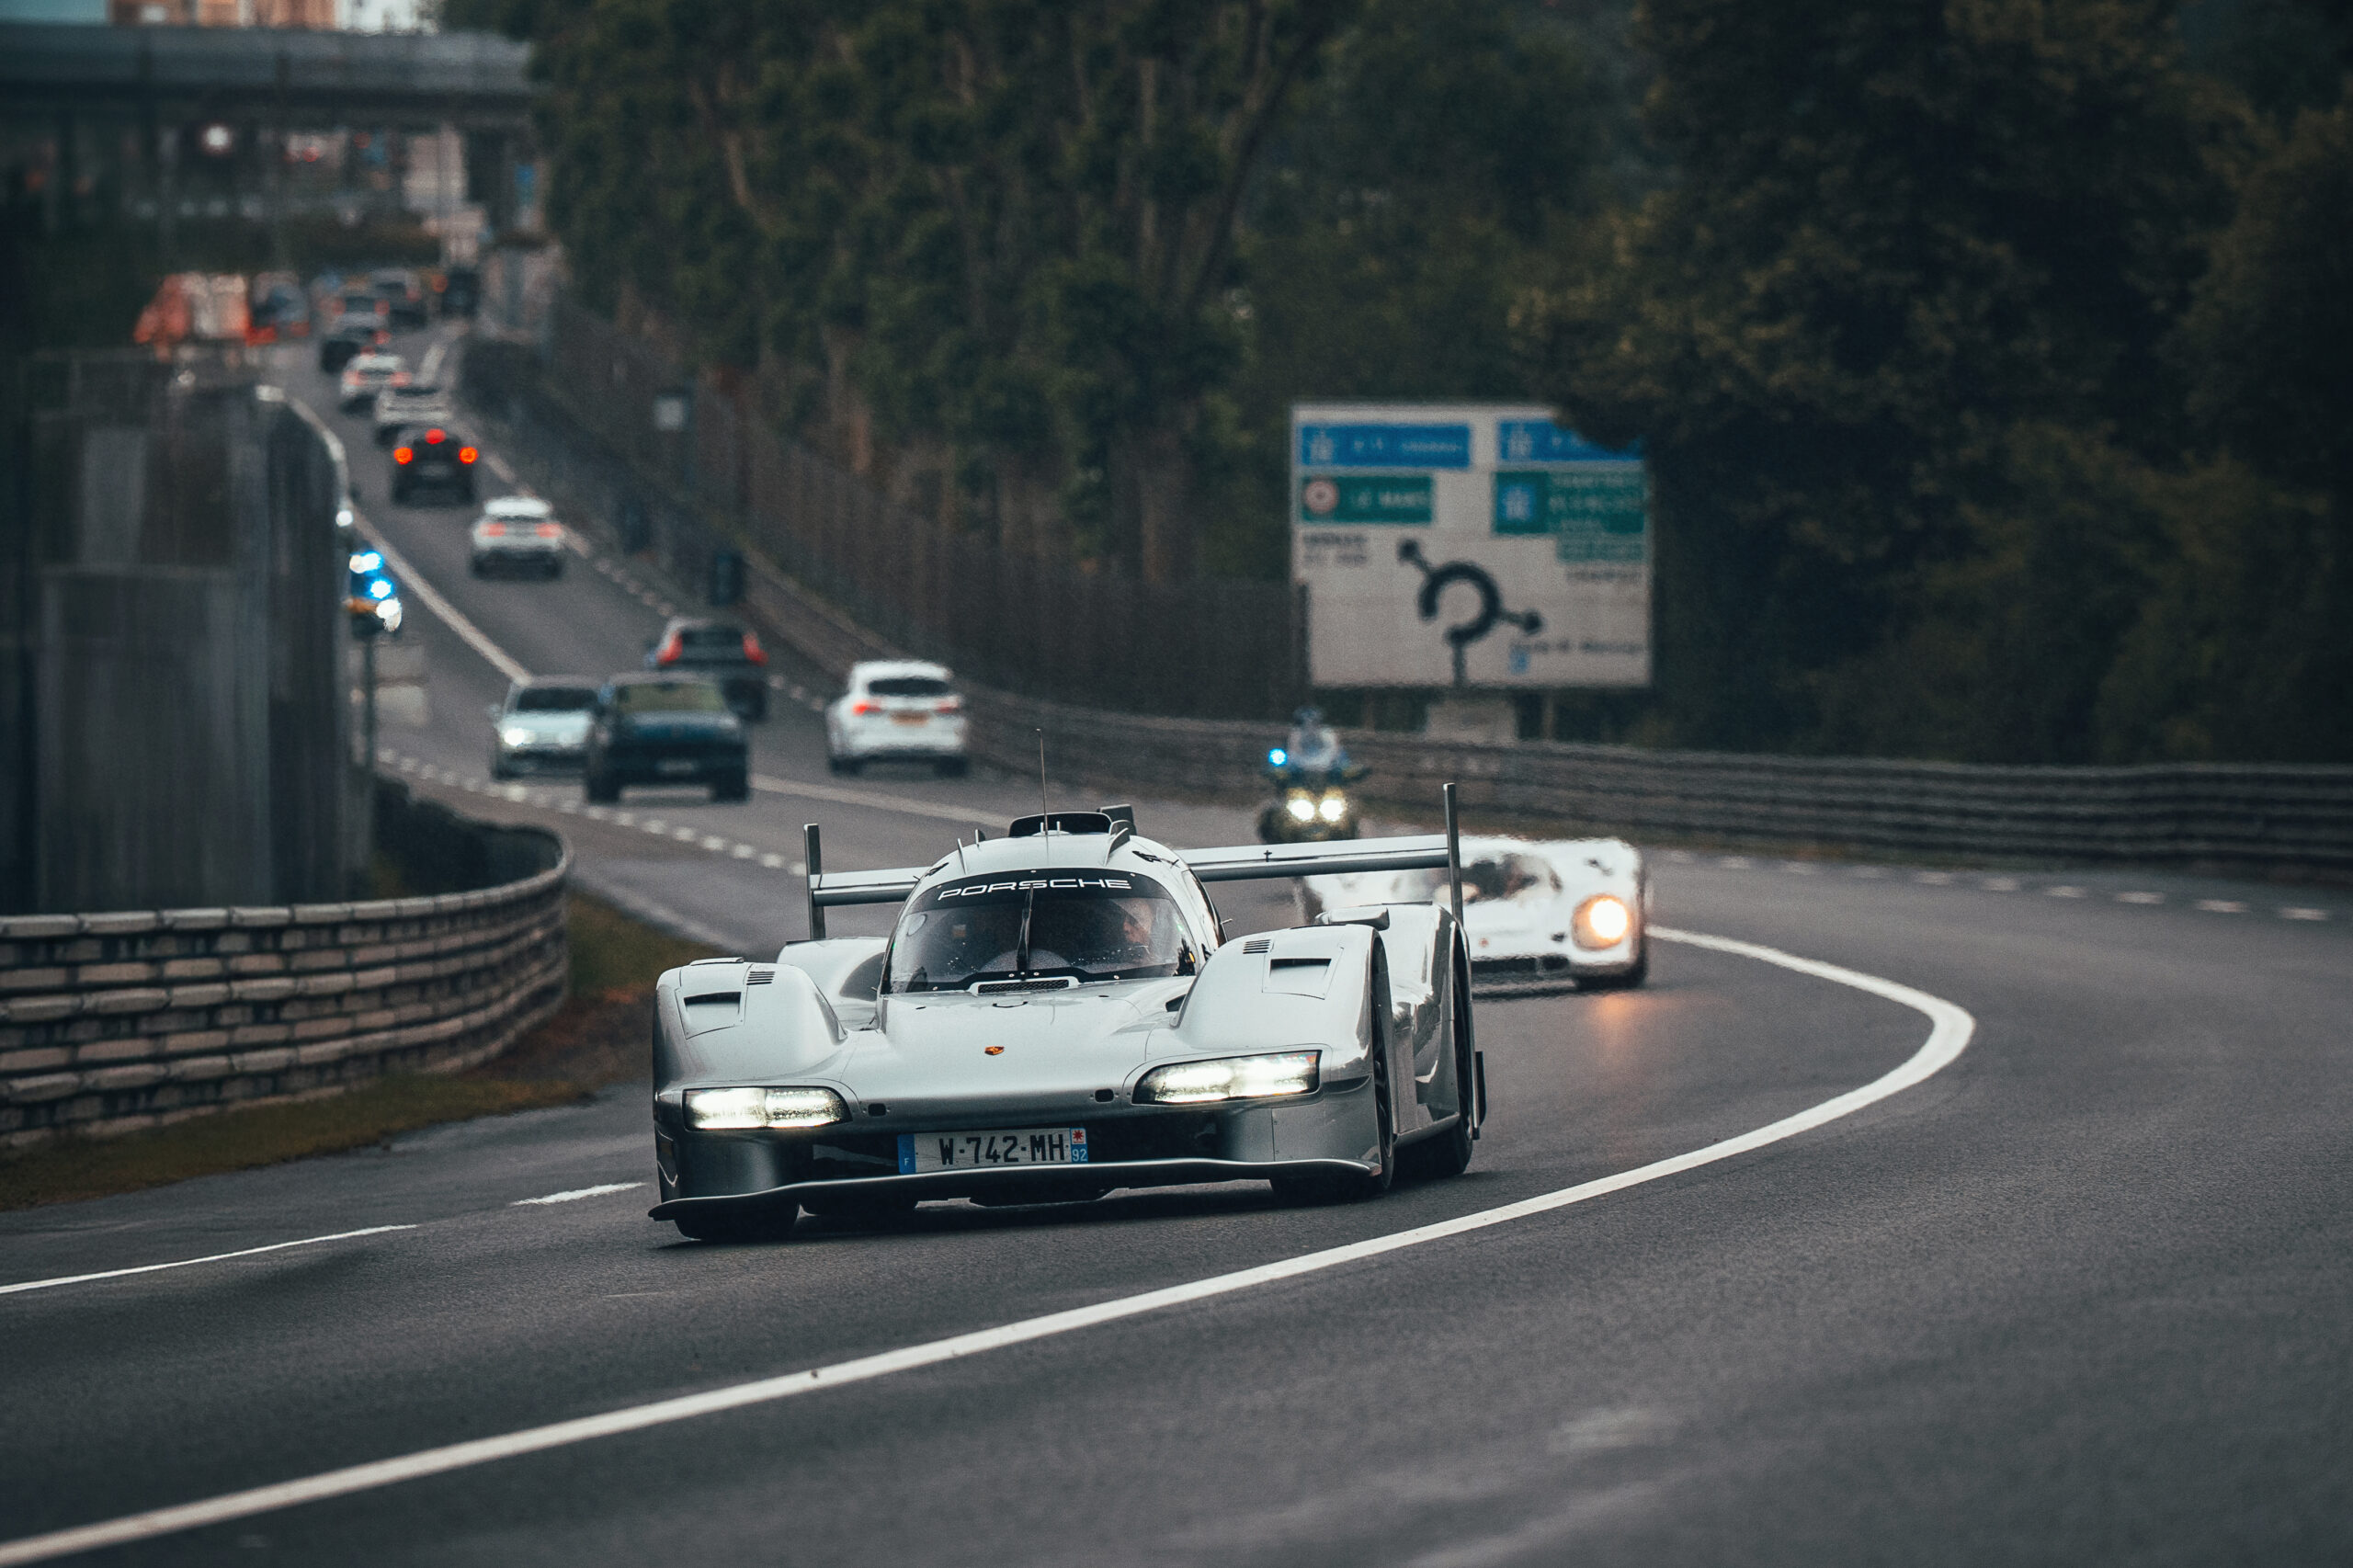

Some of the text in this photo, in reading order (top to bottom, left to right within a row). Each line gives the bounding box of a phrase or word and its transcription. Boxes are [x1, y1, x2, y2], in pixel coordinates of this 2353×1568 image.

[937, 878, 1132, 902] PORSCHE
[938, 1133, 1065, 1165] W-742-MH
[1071, 1148, 1088, 1163] 92
[904, 1157, 911, 1166] F
